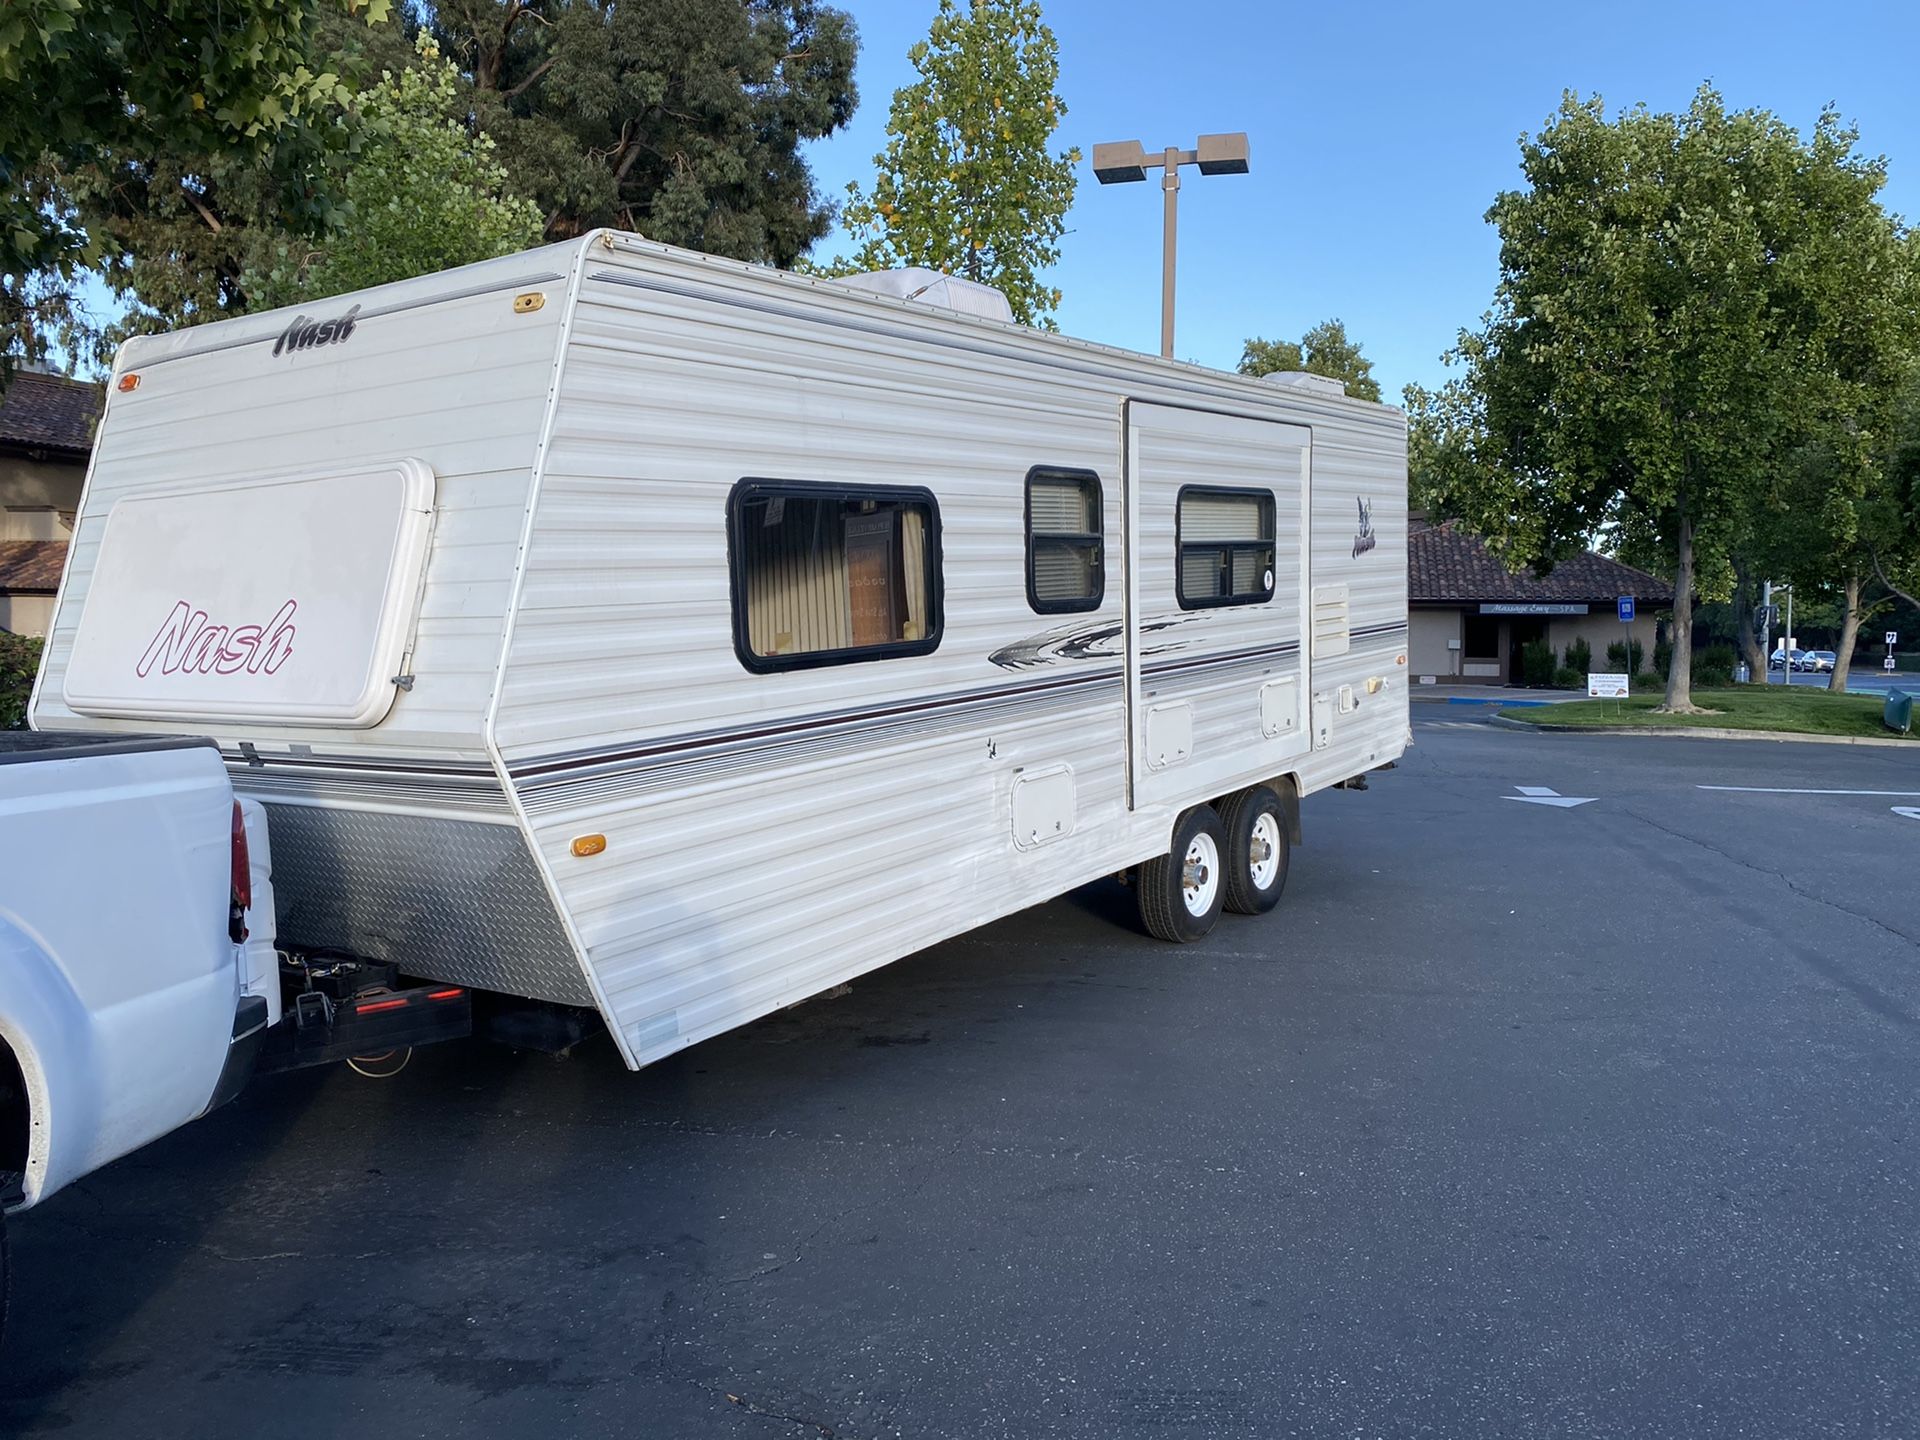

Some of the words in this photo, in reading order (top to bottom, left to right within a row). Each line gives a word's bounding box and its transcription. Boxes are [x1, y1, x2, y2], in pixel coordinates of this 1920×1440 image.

[272, 304, 361, 358] Nash
[1559, 604, 1576, 613] SPA
[136, 599, 297, 678] Nash
